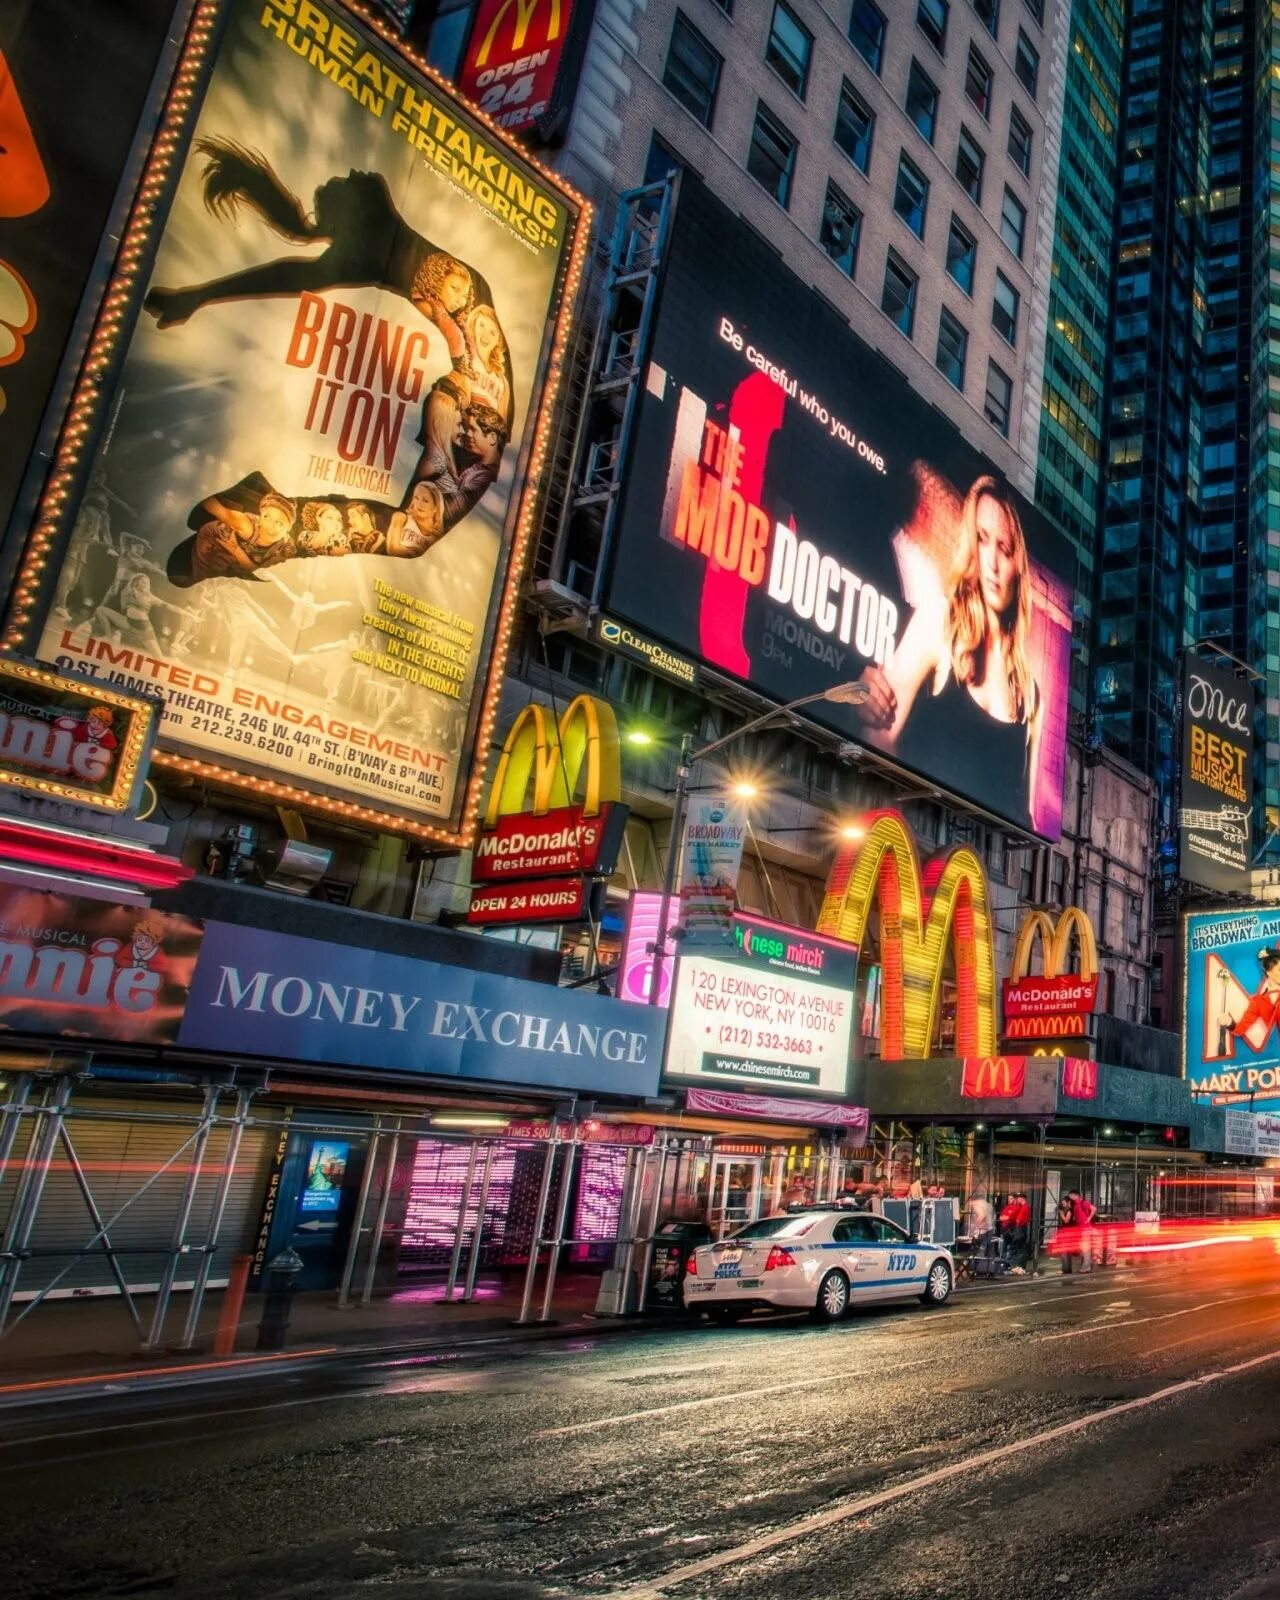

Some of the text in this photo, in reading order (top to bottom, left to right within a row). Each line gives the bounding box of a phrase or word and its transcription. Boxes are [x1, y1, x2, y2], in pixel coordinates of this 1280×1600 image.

[260, 5, 385, 118] HUMAN
[476, 49, 550, 88] OPEN
[479, 75, 535, 112] 24
[423, 159, 541, 256] THE NEW YORK TIMES
[285, 290, 430, 404] BRING
[720, 317, 888, 475] Be careful who you owe.
[304, 378, 408, 471] IT ON
[703, 418, 745, 487] THE
[306, 455, 393, 495] THE MUSICAL
[674, 458, 771, 587] MOB
[373, 577, 474, 634] The new musical from
[378, 596, 401, 619] Tony
[768, 522, 899, 666] DOCTOR
[363, 613, 458, 661] creators of AVENUE
[766, 609, 847, 672] MONDAY
[352, 649, 462, 699] and NEXT TO NORMAL
[387, 638, 466, 682] IN THE HEIGHTS
[60, 630, 448, 773] LIMITED ENGAGEMENT
[103, 671, 165, 698] JAMES
[168, 688, 236, 726] THEATRE,
[239, 713, 268, 733] 246
[191, 716, 294, 759] 212.239.6200
[1191, 724, 1247, 775] BEST
[1191, 755, 1247, 794] MUSICAL
[477, 826, 597, 857] McDonald's
[688, 825, 744, 841] BROADWAY
[1188, 832, 1247, 863] oncemusical.com
[492, 851, 573, 872] Restaurant
[471, 891, 577, 912] OPEN 24 HOURS
[17, 923, 88, 946] MUSICAL
[1195, 915, 1258, 937] IT'S EVERYTHING
[787, 943, 824, 969] mirch
[690, 969, 846, 1017] 120 LEXINGTON AVENUE
[694, 992, 836, 1033] NEW YORK, NY 10016
[1008, 987, 1093, 1003] McDonald's
[1021, 1001, 1077, 1012] Restaurant
[210, 965, 649, 1065] MONEY EXCHANGE
[719, 1025, 813, 1056] (212) 532-3663
[716, 1058, 810, 1081] www.chinesemirch.com
[1190, 1070, 1244, 1099] MARY
[507, 1126, 531, 1137] TIMES
[533, 1127, 567, 1139] SQURE
[253, 1174, 280, 1276] EXCHANGE
[714, 1269, 742, 1279] POLICE
[718, 1263, 739, 1271] NYPD
[887, 1253, 917, 1272] NYPD
